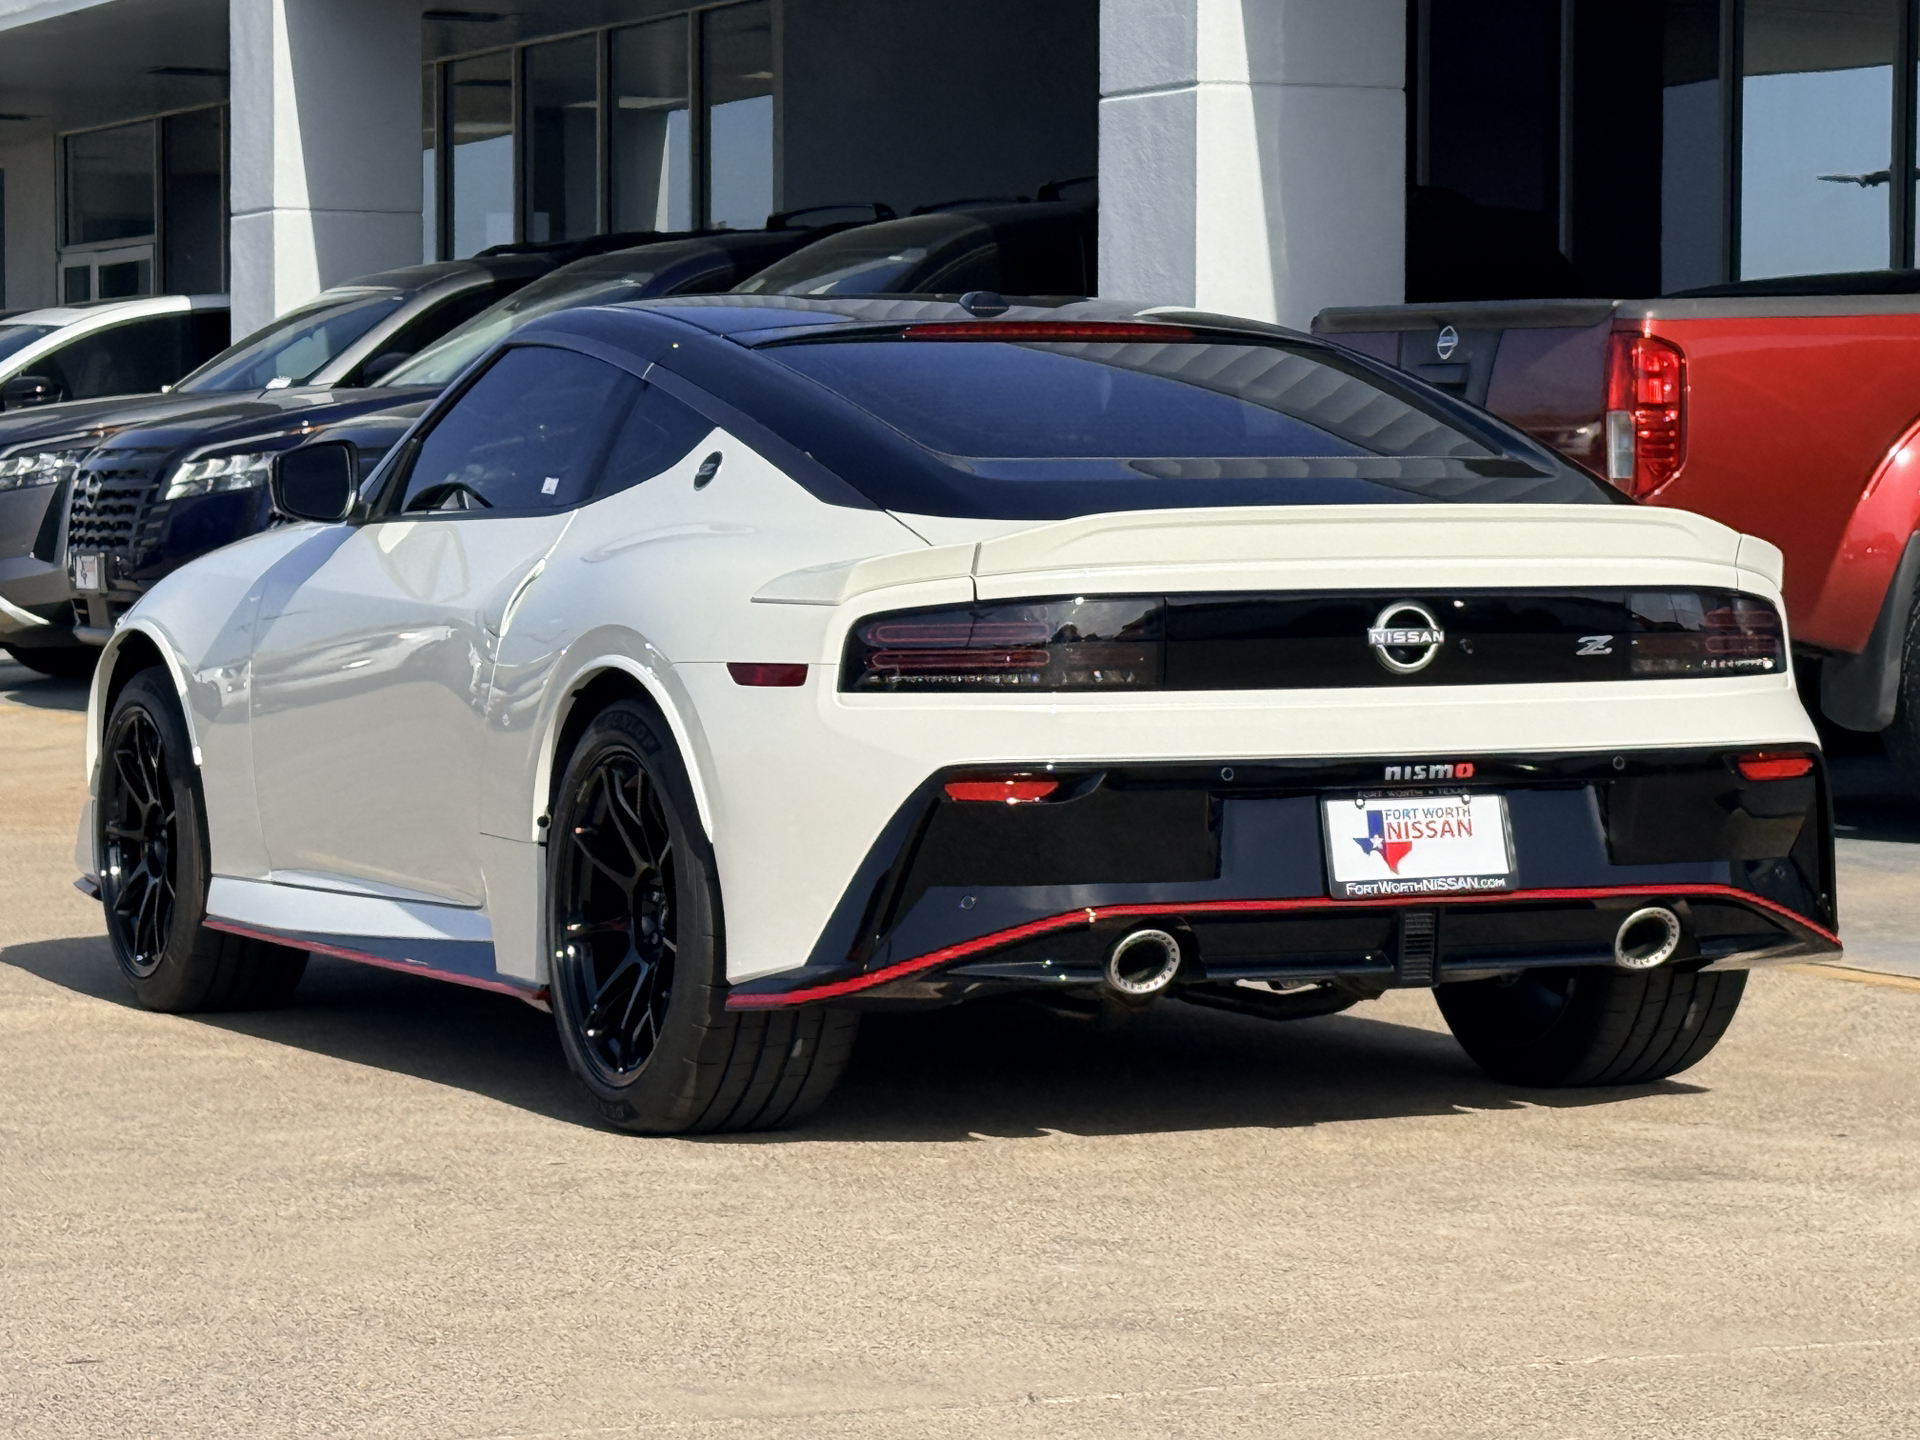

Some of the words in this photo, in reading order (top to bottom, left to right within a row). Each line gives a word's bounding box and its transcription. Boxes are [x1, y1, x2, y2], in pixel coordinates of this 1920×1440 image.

[1370, 629, 1444, 645] NISSAN
[1576, 635, 1615, 656] Z
[1384, 807, 1419, 821] FORT
[1422, 805, 1472, 819] WORTH
[1386, 818, 1473, 840] NISSAN
